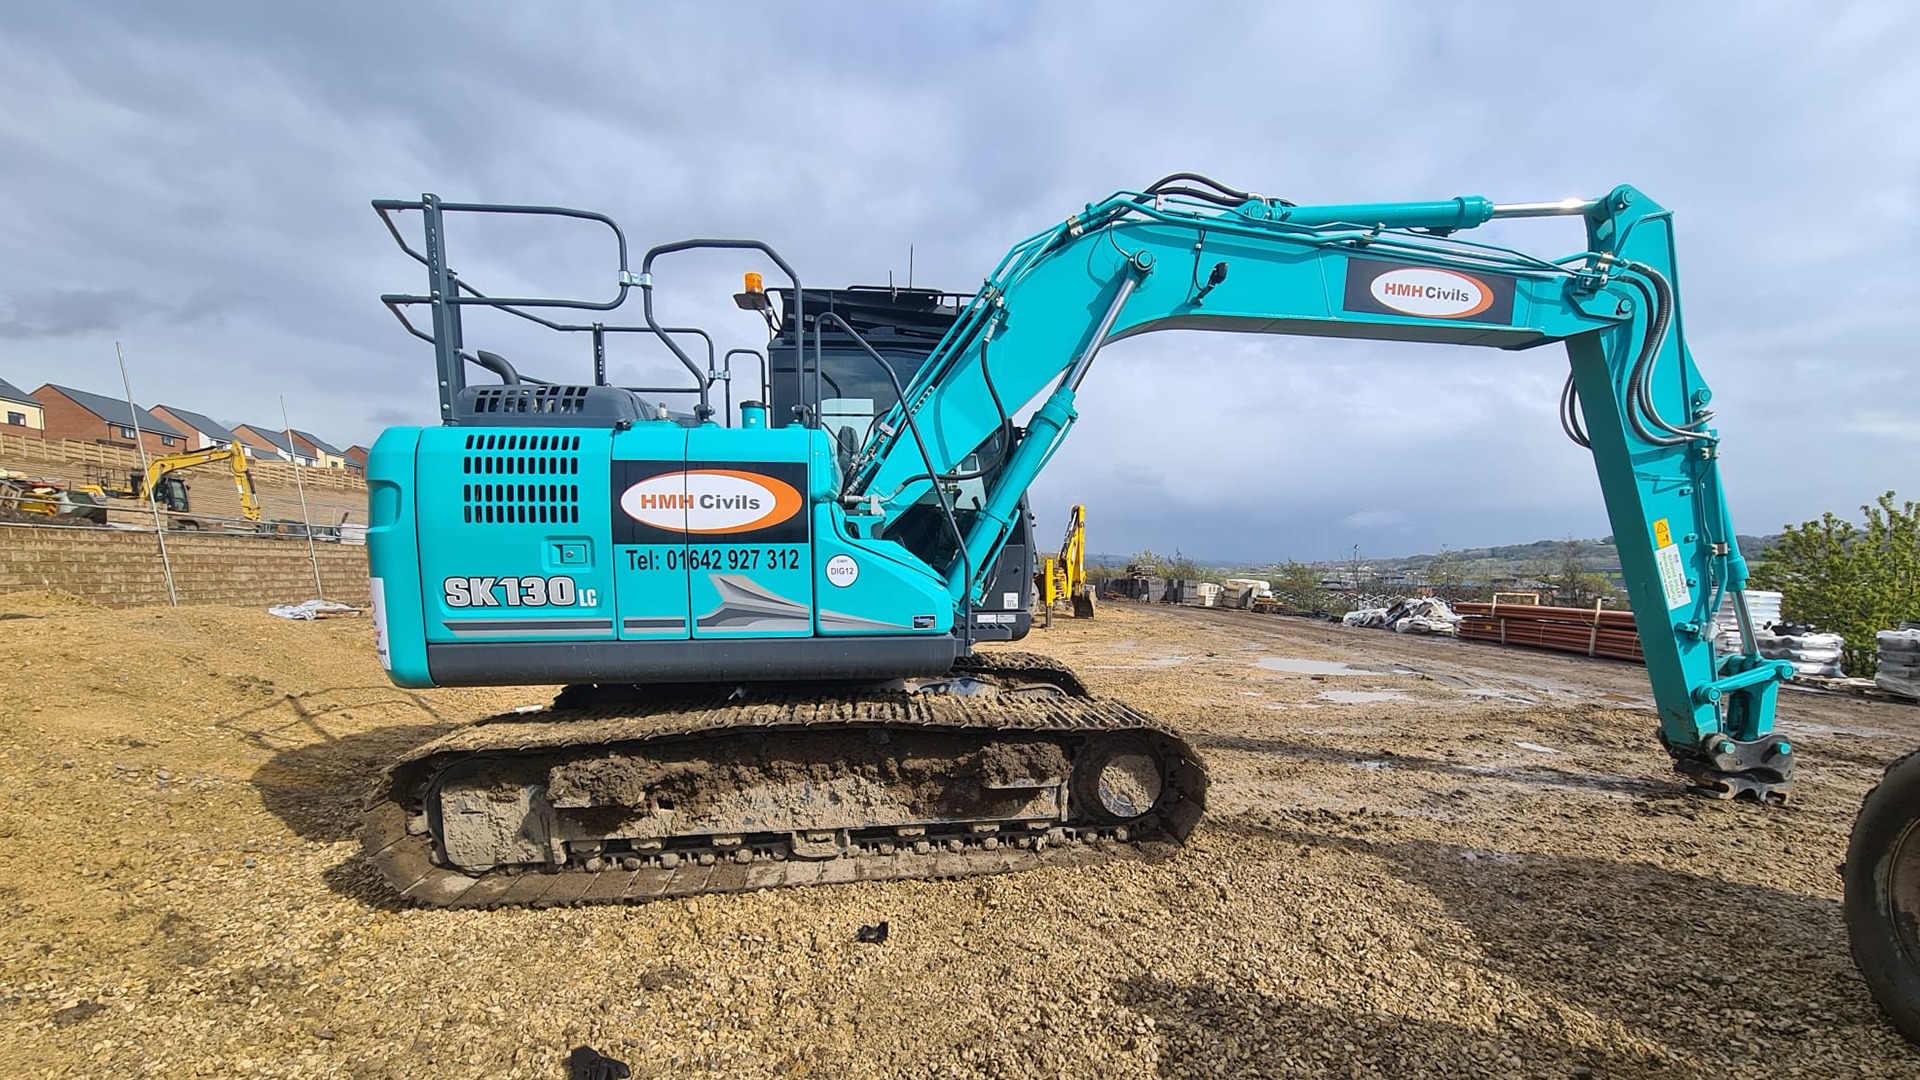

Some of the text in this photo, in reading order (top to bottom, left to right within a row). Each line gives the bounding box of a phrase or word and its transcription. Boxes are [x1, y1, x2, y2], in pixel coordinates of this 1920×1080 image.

[1384, 282, 1470, 302] HMH Civils
[640, 494, 761, 510] HMH Civils
[625, 549, 799, 571] Tel: 01642 927 312
[830, 567, 854, 575] DIG12
[444, 576, 597, 608] SK130 LC
